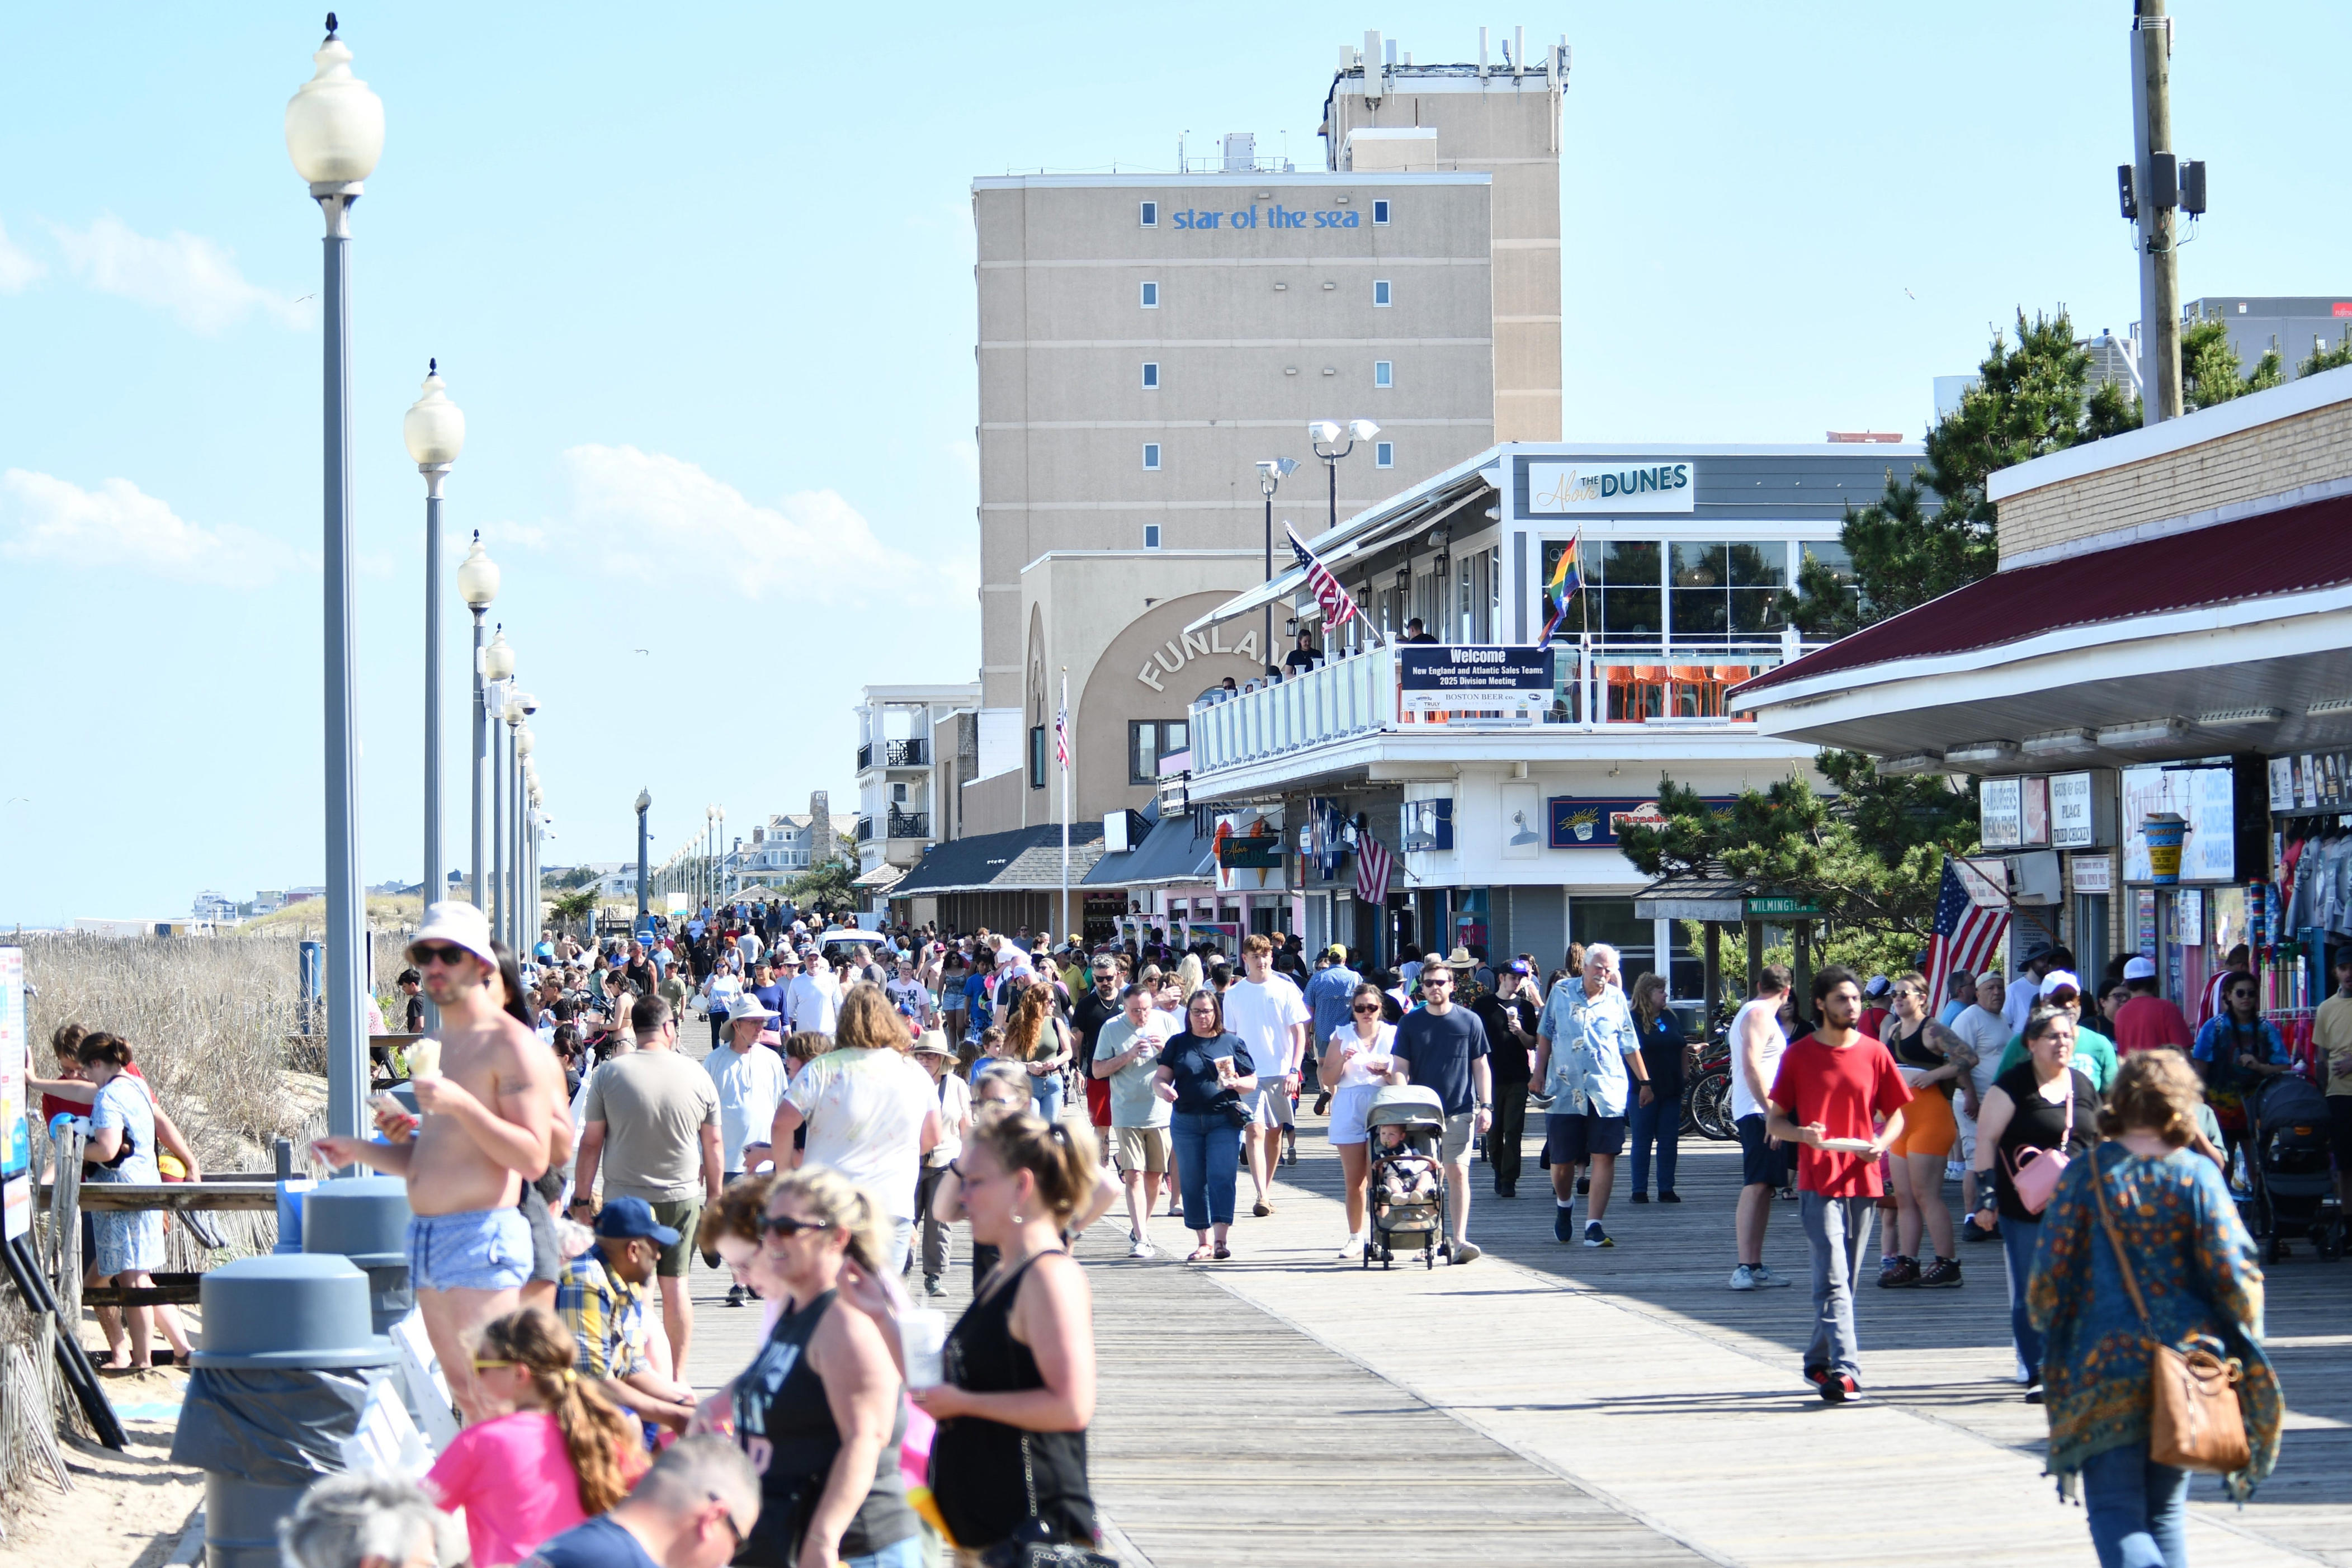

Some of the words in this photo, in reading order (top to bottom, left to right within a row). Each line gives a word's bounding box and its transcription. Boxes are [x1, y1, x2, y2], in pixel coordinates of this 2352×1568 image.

[1173, 209, 1224, 229] star
[1231, 205, 1257, 228] of
[1268, 205, 1306, 228] the
[1314, 210, 1359, 228] sea
[1536, 470, 1599, 511] Above
[1580, 475, 1599, 487] THE
[1601, 464, 1688, 498] DUNES
[1137, 626, 1291, 693] FUNLAN
[1451, 649, 1506, 663] Welcome
[1413, 667, 1426, 675] New
[1429, 667, 1456, 677] England
[1457, 666, 1470, 674] and
[1472, 666, 1499, 674] Atlantic
[1501, 666, 1519, 674] Sales
[1522, 666, 1543, 674] Teams
[1440, 677, 1458, 685] 2025
[1460, 677, 1487, 685] Division
[1489, 677, 1516, 687] Meeting
[2054, 782, 2066, 797] GUS
[2068, 782, 2074, 796] &
[2075, 780, 2087, 796] GUS
[2062, 804, 2081, 819] PLACE
[2053, 828, 2067, 844] FRIED
[2068, 826, 2090, 842] CHICKEN
[1224, 840, 1248, 860] Above
[1751, 900, 1807, 911] WILMINGTON
